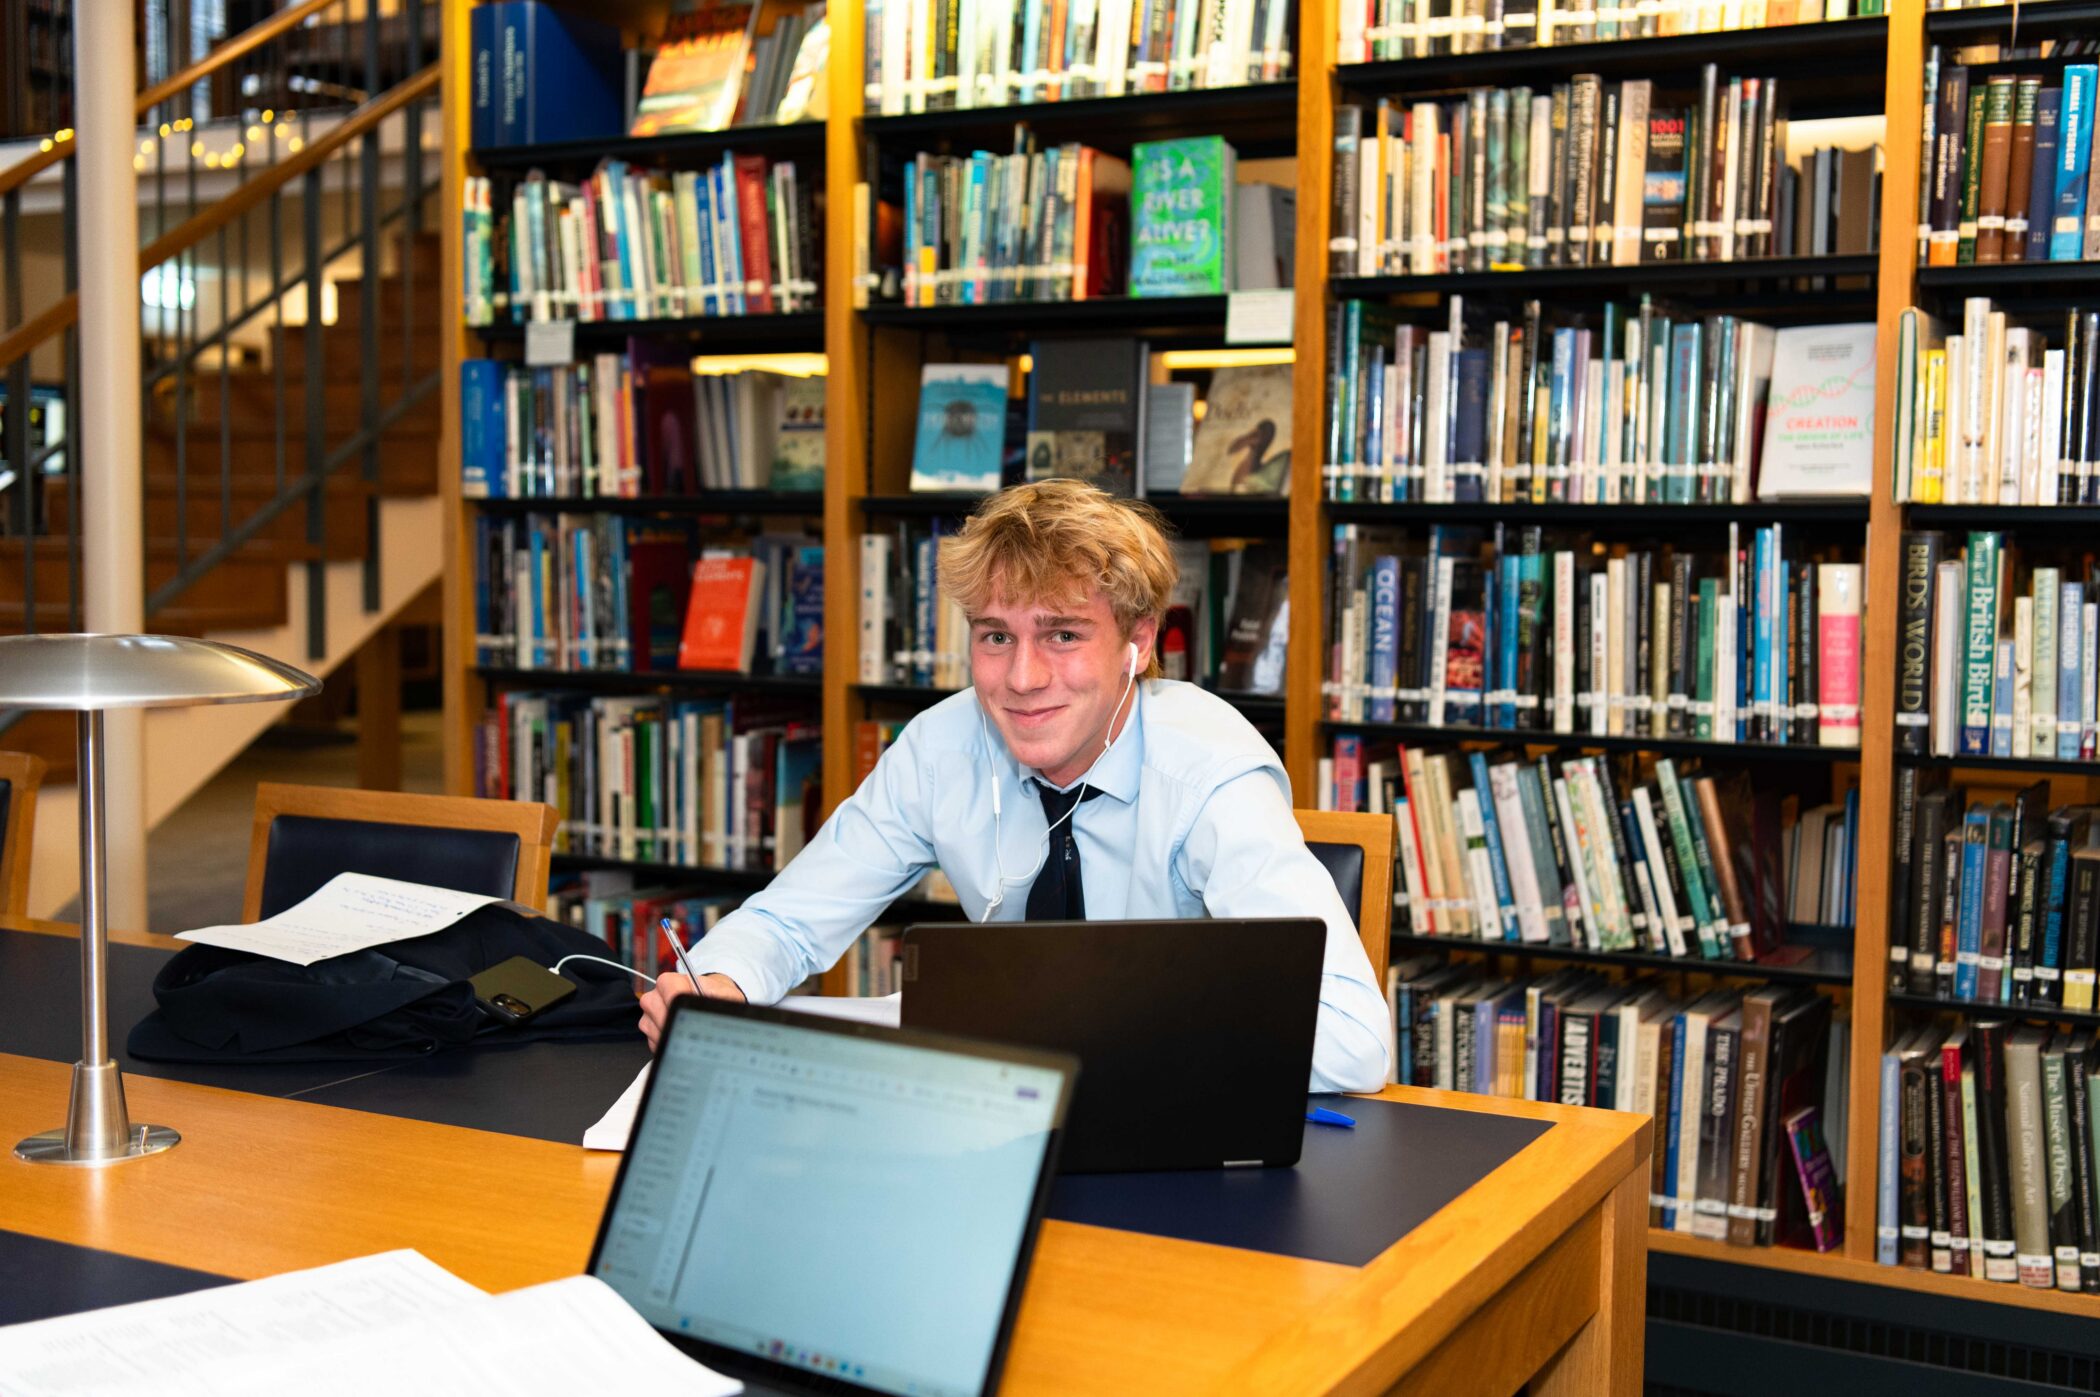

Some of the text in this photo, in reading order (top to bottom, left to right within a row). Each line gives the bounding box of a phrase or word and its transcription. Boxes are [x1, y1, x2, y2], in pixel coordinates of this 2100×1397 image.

[1650, 119, 1684, 133] 1001
[2064, 76, 2080, 171] ANIMAL PHYSIOLOGY
[1786, 417, 1858, 430] CREATION
[1375, 569, 1396, 652] OCEAN
[1902, 544, 1929, 710] BIRDS WORLD
[1969, 587, 1994, 659] British
[1967, 662, 1991, 716] Birds
[1711, 1033, 1731, 1116] THE PRADO
[2046, 1062, 2062, 1094] The
[2017, 1081, 2033, 1129] National
[2049, 1096, 2065, 1143] Musée
[2020, 1131, 2035, 1172] Gallery
[2024, 1186, 2035, 1205] Art
